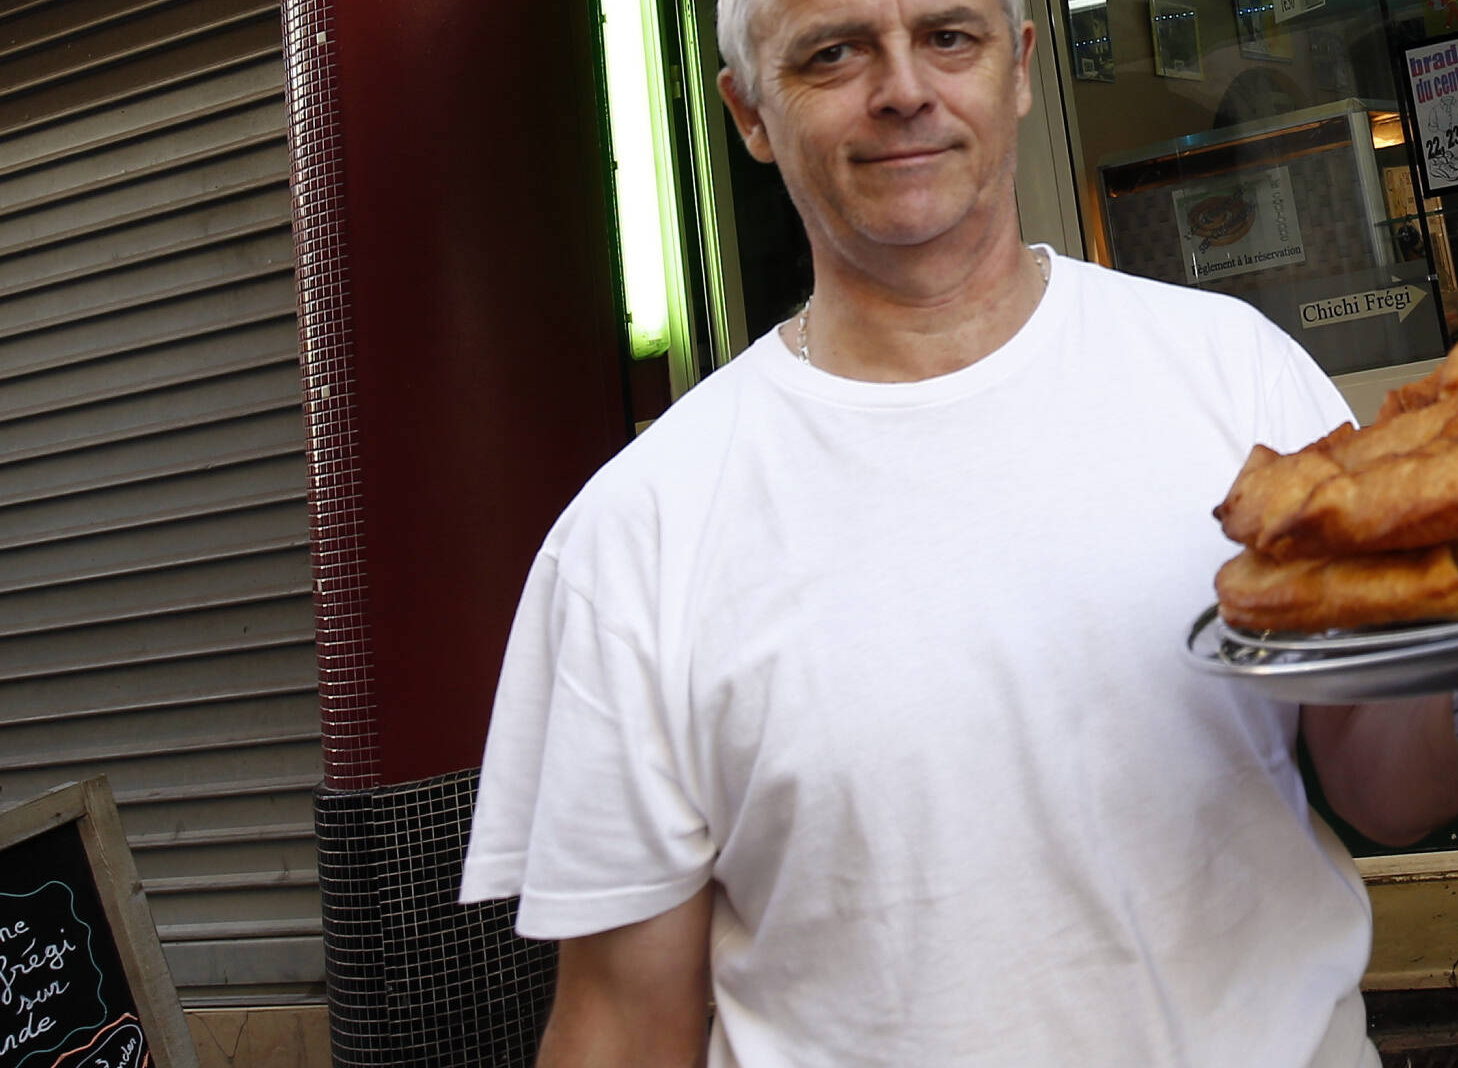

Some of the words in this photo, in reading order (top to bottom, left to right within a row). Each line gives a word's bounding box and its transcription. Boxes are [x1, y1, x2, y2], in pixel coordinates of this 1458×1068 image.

[1416, 78, 1434, 103] du
[1237, 257, 1243, 266] à
[1244, 253, 1254, 264] la
[1254, 245, 1302, 263] réservation
[1303, 296, 1360, 322] Chichi
[1364, 286, 1411, 311] Frégi
[16, 980, 70, 1015] sur
